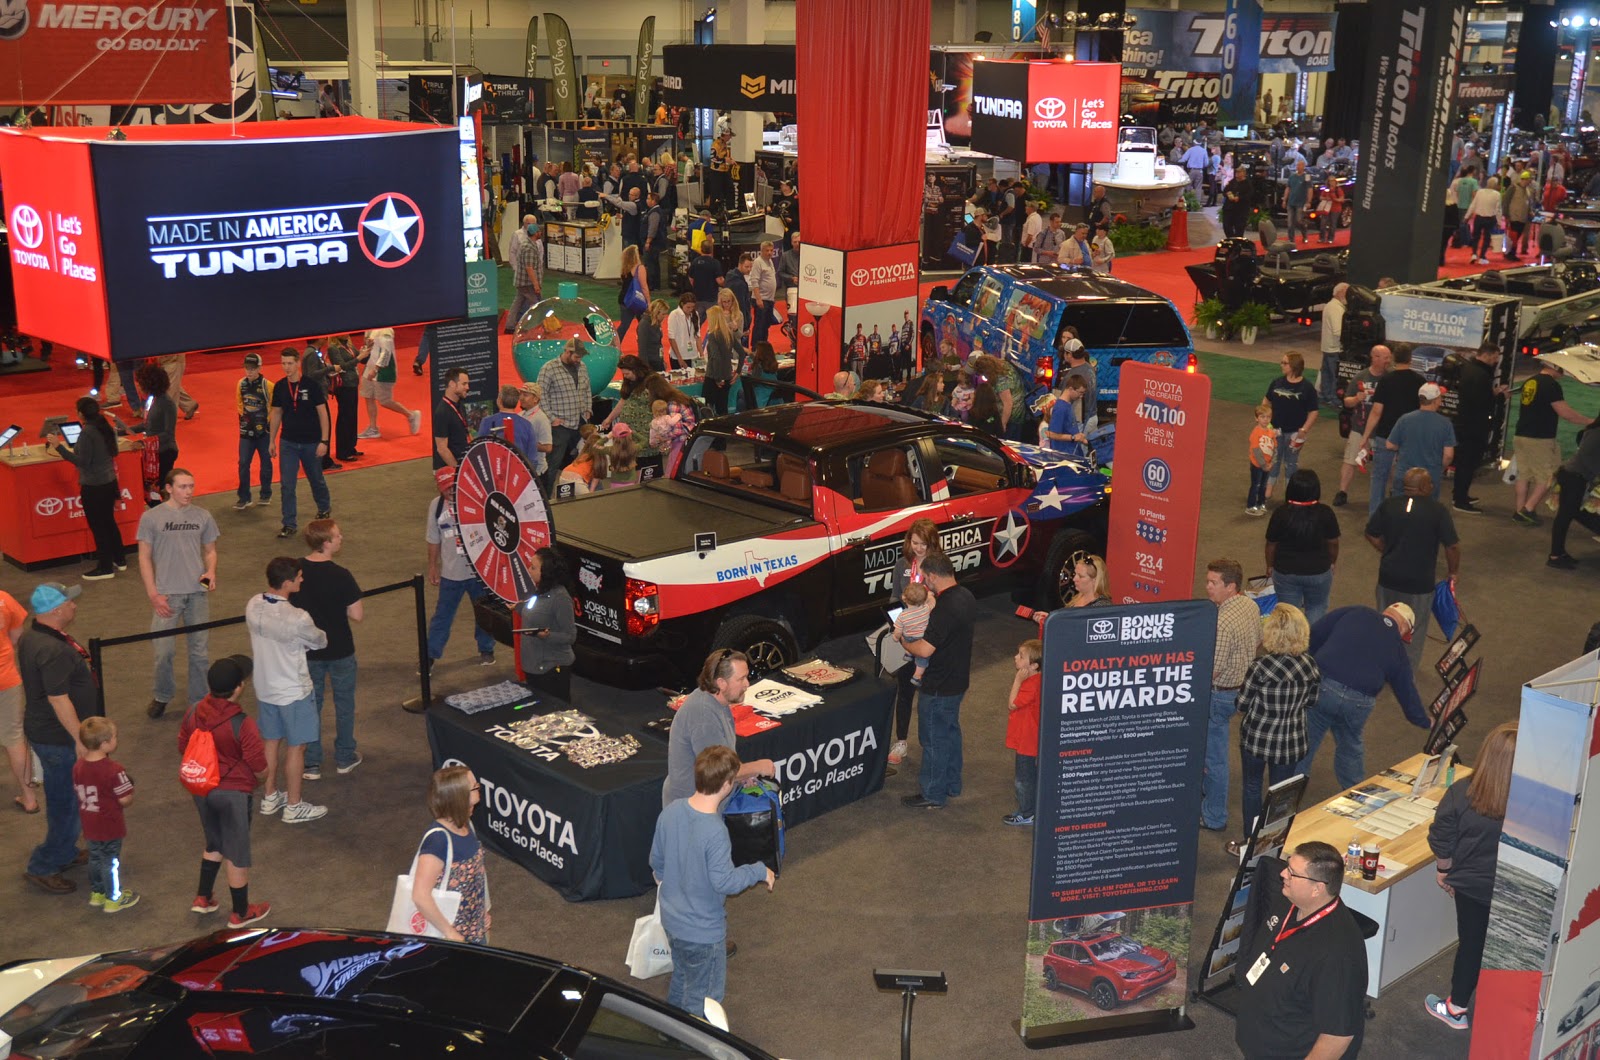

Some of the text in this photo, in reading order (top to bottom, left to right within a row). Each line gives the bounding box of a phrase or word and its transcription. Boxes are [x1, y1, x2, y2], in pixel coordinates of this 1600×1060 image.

[37, 4, 217, 31] MERCURY
[96, 38, 125, 51] GO
[552, 38, 569, 98] Go RVing
[1307, 56, 1329, 66] BOATS
[1390, 7, 1426, 126] Triton
[1441, 5, 1465, 125] Triton
[639, 42, 653, 104] Go RVing
[492, 83, 518, 91] TRIPLE
[974, 95, 1022, 120] TUNDRA
[1082, 98, 1105, 109] Let's
[1081, 109, 1097, 119] Go
[1032, 119, 1112, 129] TOYOTA Places
[1362, 56, 1390, 210] We Take America Fishing
[1384, 124, 1400, 170] BOATS
[56, 213, 82, 236] Let's
[148, 212, 344, 245] MADE IN AMERICA
[59, 235, 77, 256] Go
[13, 249, 51, 271] TOYOTA
[151, 240, 348, 279] TUNDRA
[62, 257, 97, 282] Places
[823, 266, 834, 275] Let's
[870, 262, 915, 280] TOYOTA
[467, 287, 489, 295] TOYOTA
[823, 279, 838, 289] Places
[870, 278, 896, 286] FISHING
[1403, 308, 1468, 327] 38-GALLON
[1402, 320, 1465, 337] FUEL TANK
[1143, 389, 1183, 402] HAS CREATED
[1144, 378, 1183, 395] TOYOTA
[1135, 402, 1186, 427] 470,100
[1144, 426, 1174, 439] JOBS IN
[1144, 434, 1175, 449] THE U.S.
[1147, 463, 1165, 483] 60
[1149, 480, 1163, 488] YEARS
[1138, 508, 1146, 516] 10
[1146, 509, 1166, 521] Plants
[163, 521, 200, 533] Marines
[864, 546, 903, 569] MADE
[1135, 551, 1163, 572] $23.4
[716, 554, 799, 583] BORN IN TEXAS
[1141, 567, 1156, 576] BILLION
[584, 600, 618, 620] JOBS IN
[584, 609, 604, 624] THE
[1121, 613, 1175, 629] BONUS
[1089, 625, 1174, 641] TOYOTA BUCKS
[1063, 651, 1195, 673] LOYALTY NOW HAS
[1062, 664, 1193, 691] DOUBLE THE
[765, 691, 796, 704] TOYOTA
[1061, 683, 1195, 714] REWARDS.
[773, 726, 878, 783] TOYOTA
[1059, 748, 1092, 757] OVERVIEW
[804, 779, 822, 795] Go
[824, 763, 864, 787] Places
[480, 777, 579, 855] TOYOTA
[1081, 821, 1106, 829] REDEEM
[488, 813, 564, 869] Let's Go Places
